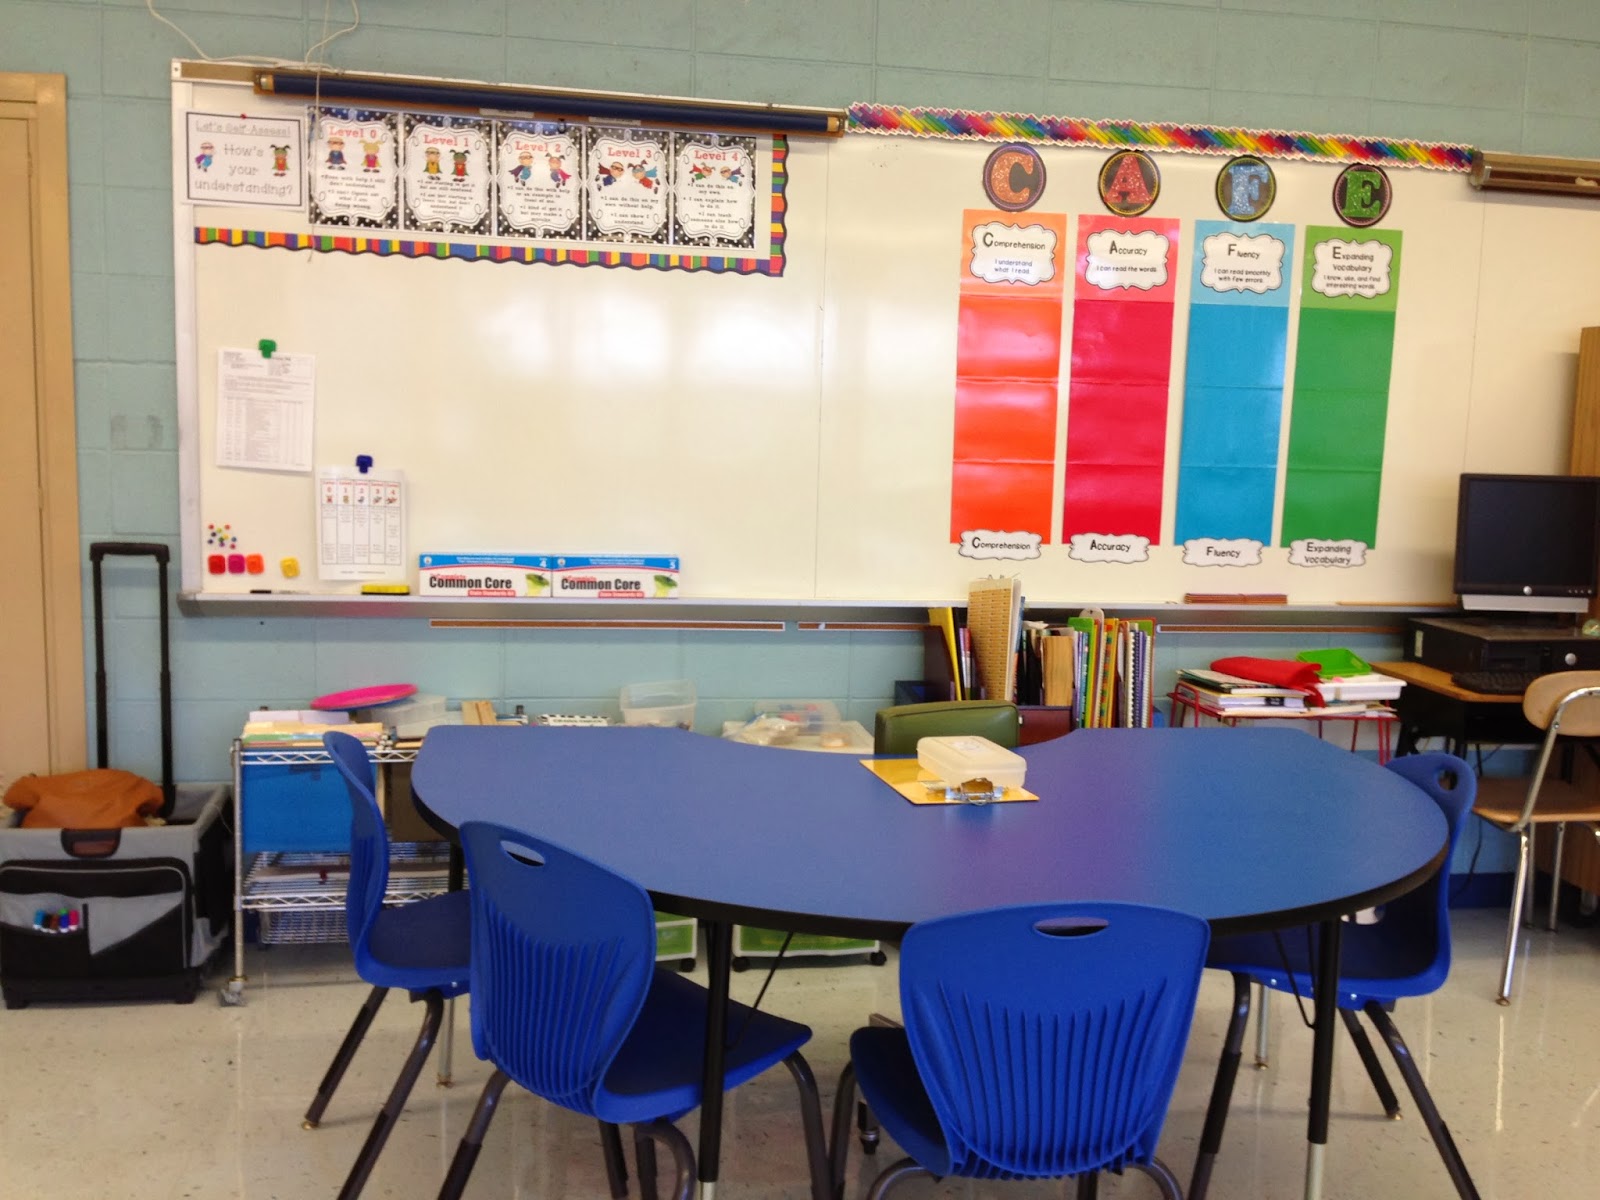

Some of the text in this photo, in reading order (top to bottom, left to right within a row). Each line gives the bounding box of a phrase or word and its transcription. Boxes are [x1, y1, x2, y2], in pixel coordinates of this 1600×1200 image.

[329, 126, 377, 138] Level 0
[423, 134, 469, 147] Level 1
[515, 141, 561, 153] Level 2
[224, 143, 264, 157] How's
[607, 147, 652, 158] Level 3
[694, 150, 738, 161] Level 4
[229, 165, 259, 176] your
[194, 180, 293, 197] understanding?
[990, 151, 1381, 218] C A F E
[983, 232, 1045, 250] Comprehension
[1109, 240, 1148, 256] Accuracy
[1227, 243, 1260, 260] Fluency
[1332, 246, 1374, 262] Expanding
[998, 259, 1033, 267] understand
[971, 536, 1031, 550] Comprehension
[1089, 539, 1131, 552] Accuracy
[1306, 541, 1352, 554] Expanding
[1206, 545, 1241, 559] Fluency
[540, 560, 547, 568] 4
[429, 576, 482, 589] Common
[484, 577, 512, 589] Core
[561, 578, 612, 590] Common
[614, 578, 641, 590] Core
